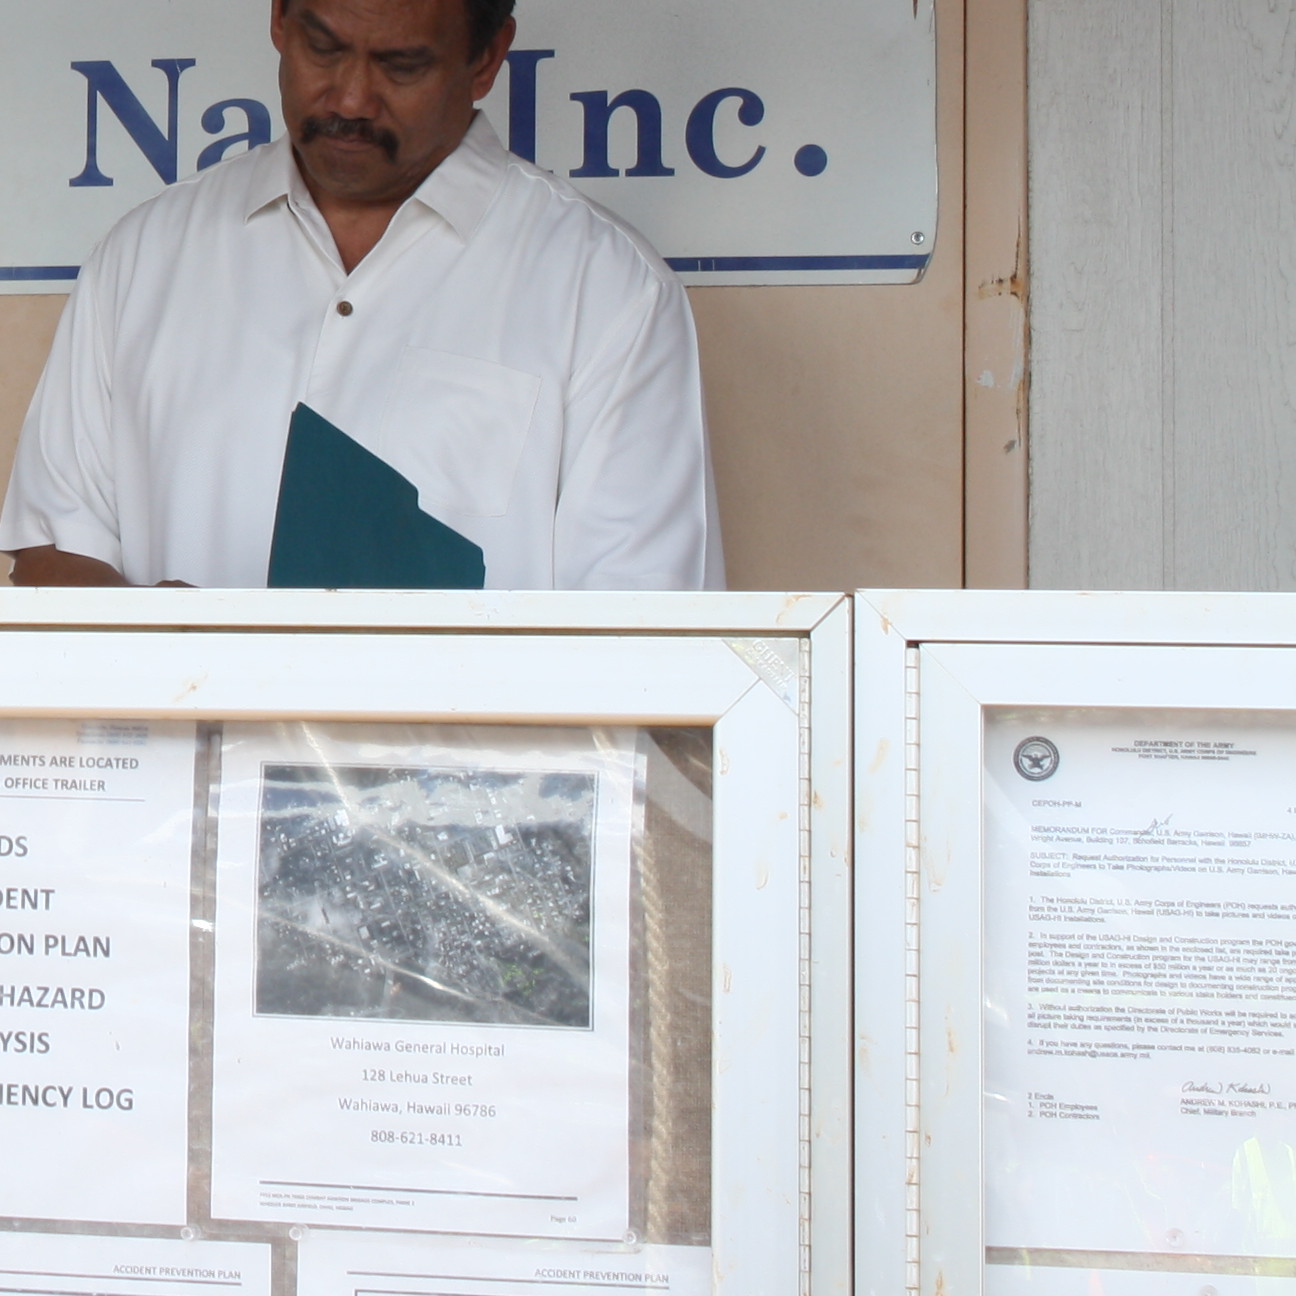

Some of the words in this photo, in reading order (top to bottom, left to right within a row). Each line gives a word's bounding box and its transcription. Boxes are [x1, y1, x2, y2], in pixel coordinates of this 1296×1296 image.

[506, 49, 828, 179] Inc.
[49, 755, 75, 768] ARE
[78, 756, 139, 769] LOCATED
[3, 776, 48, 789] OFFICE
[53, 778, 105, 791] TRAILER
[44, 934, 110, 958] PLAN
[330, 1036, 391, 1051] Wahiawa
[394, 1040, 447, 1054] General
[450, 1042, 505, 1059] Hospital
[362, 1068, 386, 1082] 128
[389, 1069, 428, 1084] Lehua
[431, 1071, 472, 1086] Street
[81, 1086, 133, 1111] LOG
[338, 1097, 403, 1114] Wahiawa,
[406, 1101, 451, 1115] Hawaii
[454, 1103, 496, 1117] 96786
[370, 1129, 461, 1146] 808-621-8411
[112, 1264, 156, 1275] ACCIDENT
[158, 1267, 215, 1278] PREVENTION
[216, 1270, 241, 1280] PLAN
[534, 1267, 581, 1279] ACCIDENT
[582, 1270, 643, 1282] PREVENTION
[643, 1273, 671, 1284] PLAN
